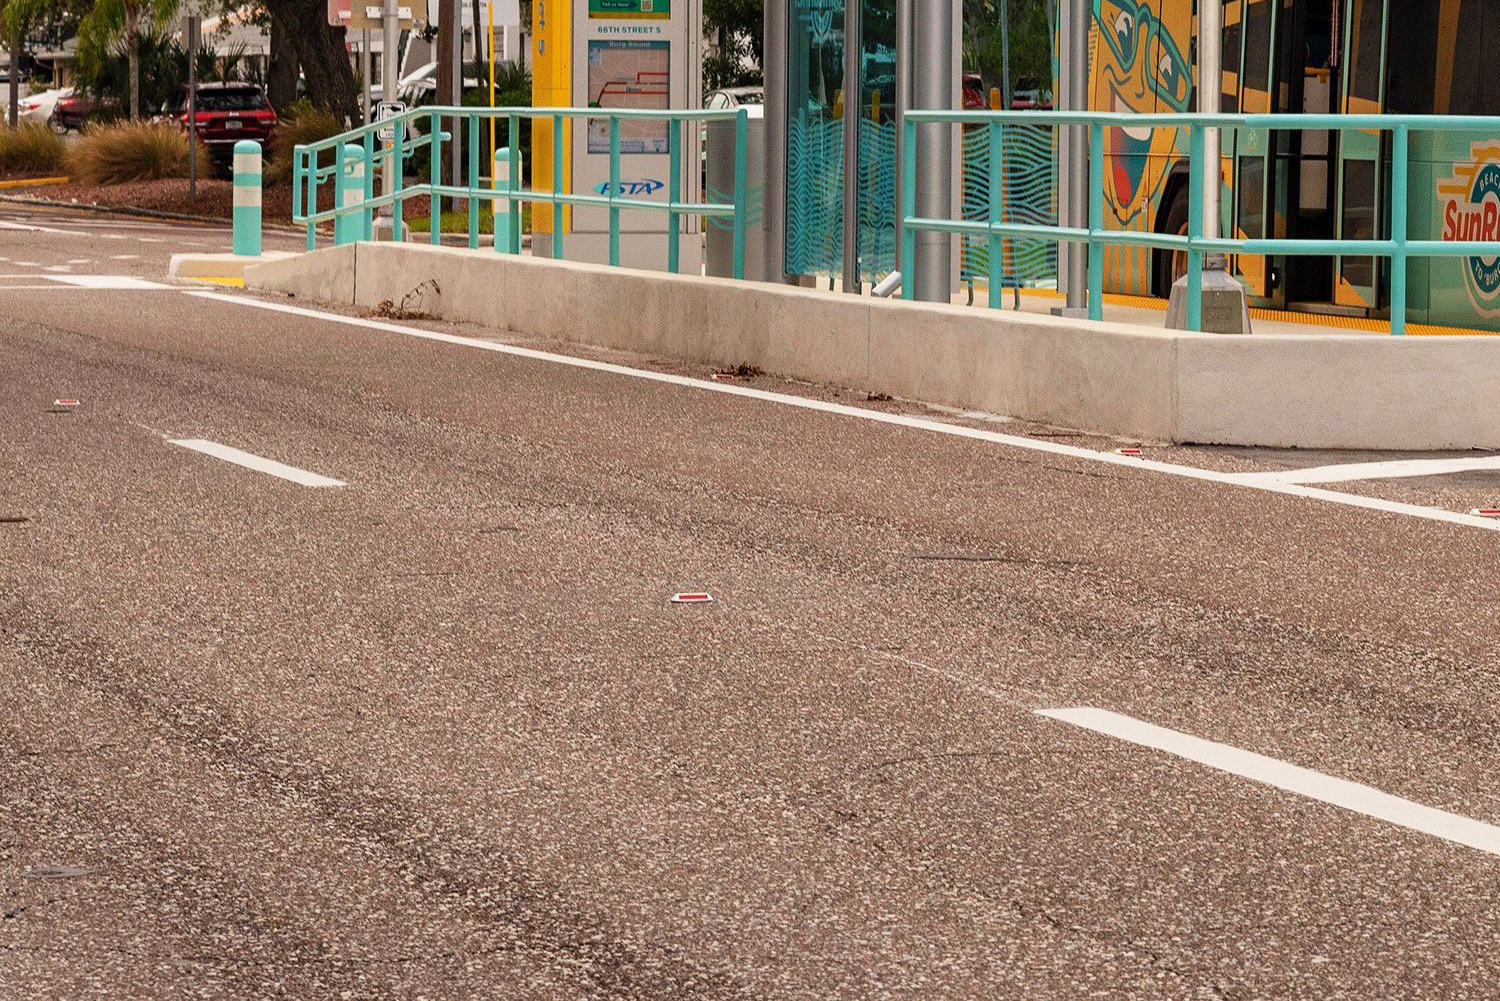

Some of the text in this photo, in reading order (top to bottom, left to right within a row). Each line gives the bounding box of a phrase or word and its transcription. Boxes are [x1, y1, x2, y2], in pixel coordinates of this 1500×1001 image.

[621, 26, 653, 34] STREET
[656, 26, 662, 34] S
[1475, 260, 1483, 280] TO
